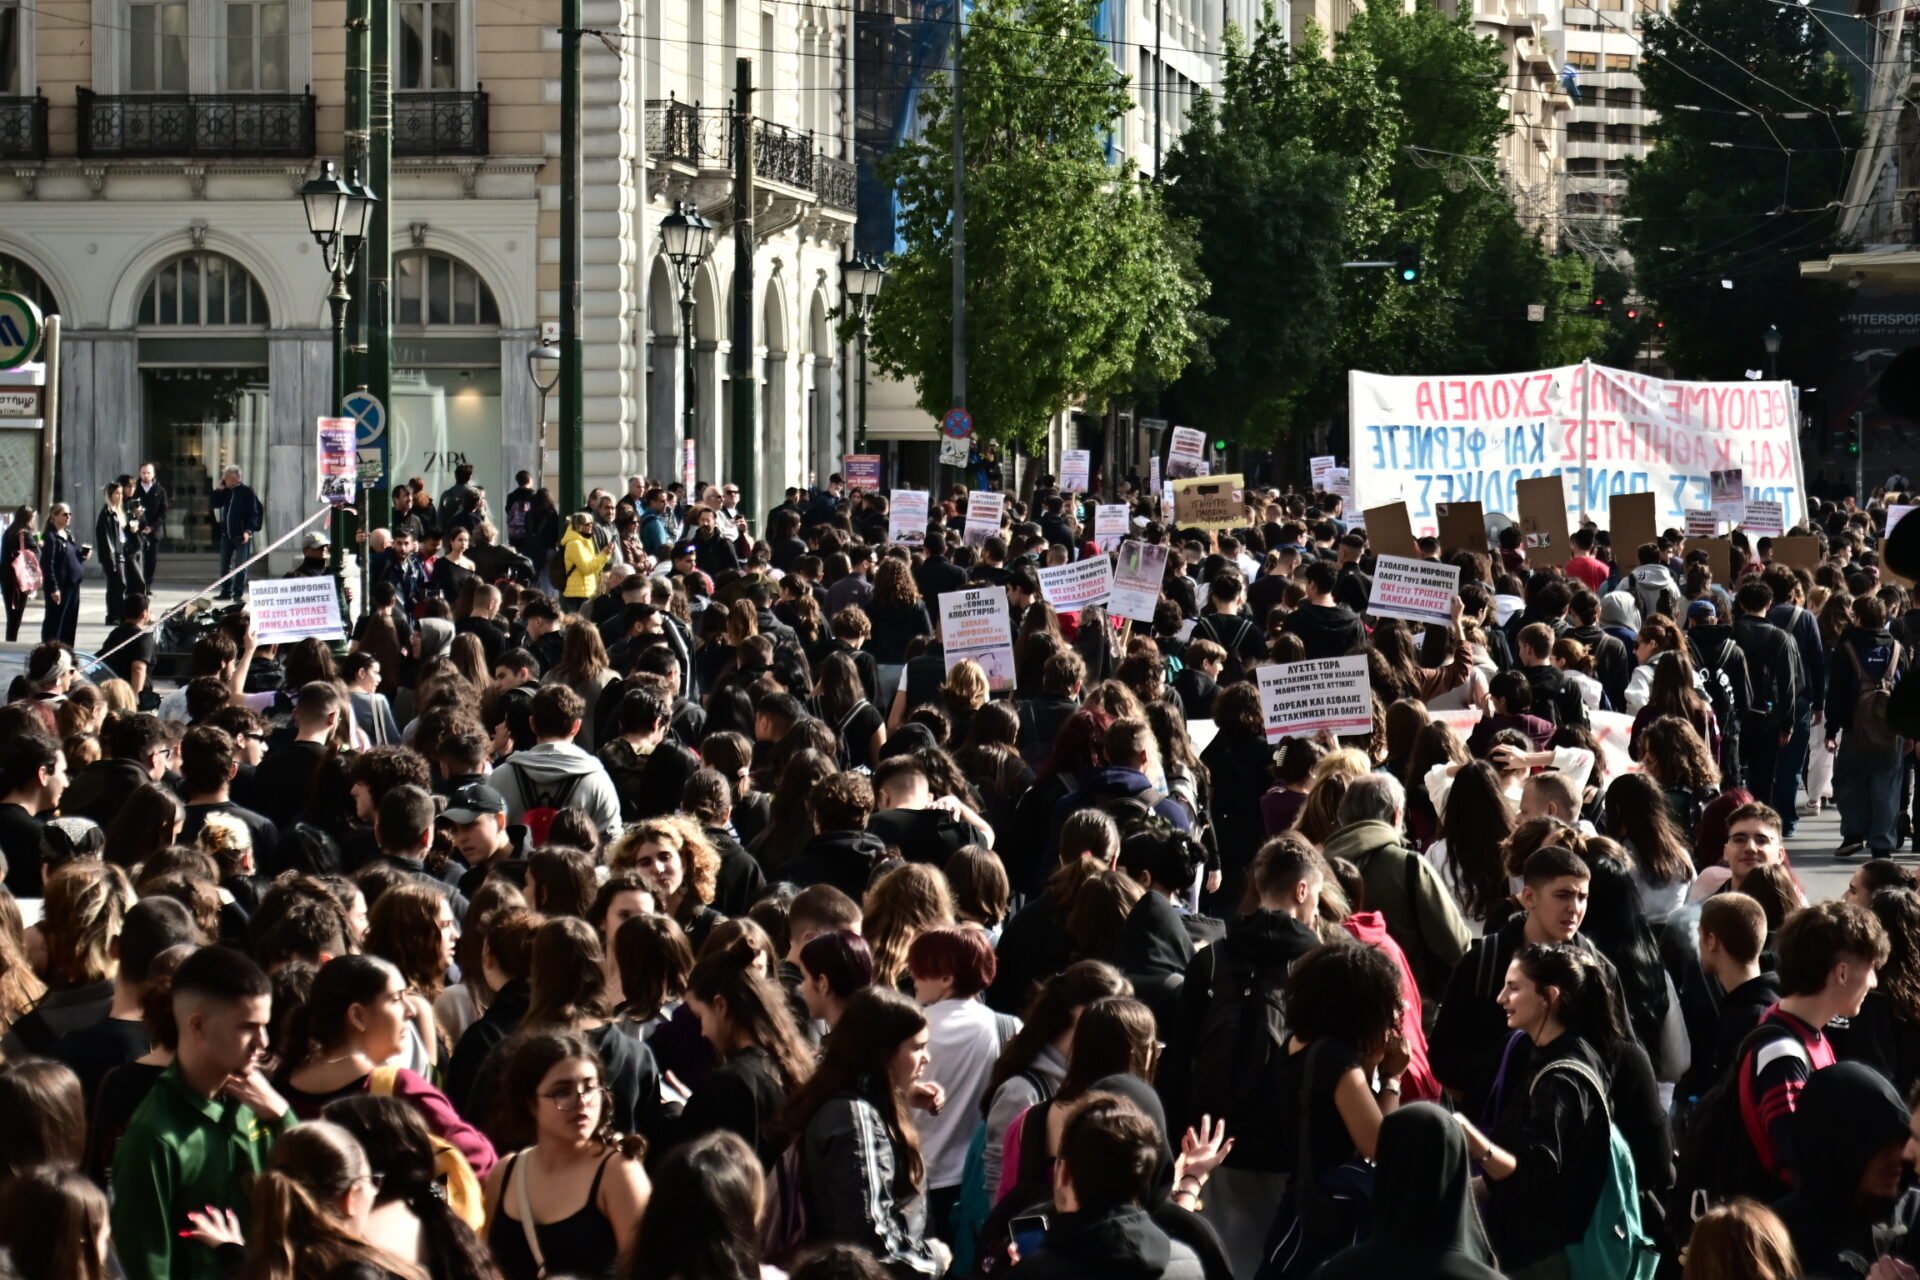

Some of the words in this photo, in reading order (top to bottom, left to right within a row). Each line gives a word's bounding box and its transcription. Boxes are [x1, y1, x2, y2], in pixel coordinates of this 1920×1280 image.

[1379, 560, 1409, 572] ΣΧΟΛΕΙΟ
[1420, 567, 1456, 579] ΜΟΡΦΩΝΕΙ
[1379, 571, 1402, 581] ΟΛΟΥΣ
[1404, 576, 1420, 584] ΤΟΥΣ
[1420, 578, 1453, 589] ΜΑΘΗΤΕΣ
[965, 591, 980, 601] ΟΧΙ
[1380, 582, 1396, 591] ΟΧΙ
[1414, 587, 1449, 600] ΤΡΙΠΛΕΣ
[1380, 593, 1446, 610] ΠΑΝΕΛΛΑΔΙΚΕΣ
[1287, 662, 1316, 674] ΛΥΣΤΕ
[1318, 660, 1340, 670] ΤΩΡΑ
[1261, 680, 1271, 688] ΤΗ
[1273, 674, 1318, 686] ΜΕΤΑΚΙΝΗΣΗ
[1320, 672, 1333, 680] ΤΩΝ
[1334, 670, 1365, 678] ΧΙΛΙΑΔΩΝ
[1275, 684, 1311, 695] ΜΑΘΗΤΩΝ
[1312, 682, 1326, 691] ΤΗΣ
[1273, 700, 1308, 712] ΔΩΡΕΑΝ
[1309, 698, 1324, 707] ΚΑΙ
[1326, 694, 1361, 705] ΑΣΦΑΛΗΣ
[1270, 709, 1326, 724] ΜΕΤΑΚΙΝΗΣΗ
[1327, 708, 1339, 716] ΓΙΑ
[1340, 706, 1366, 715] ΟΛΟΥΣ!
